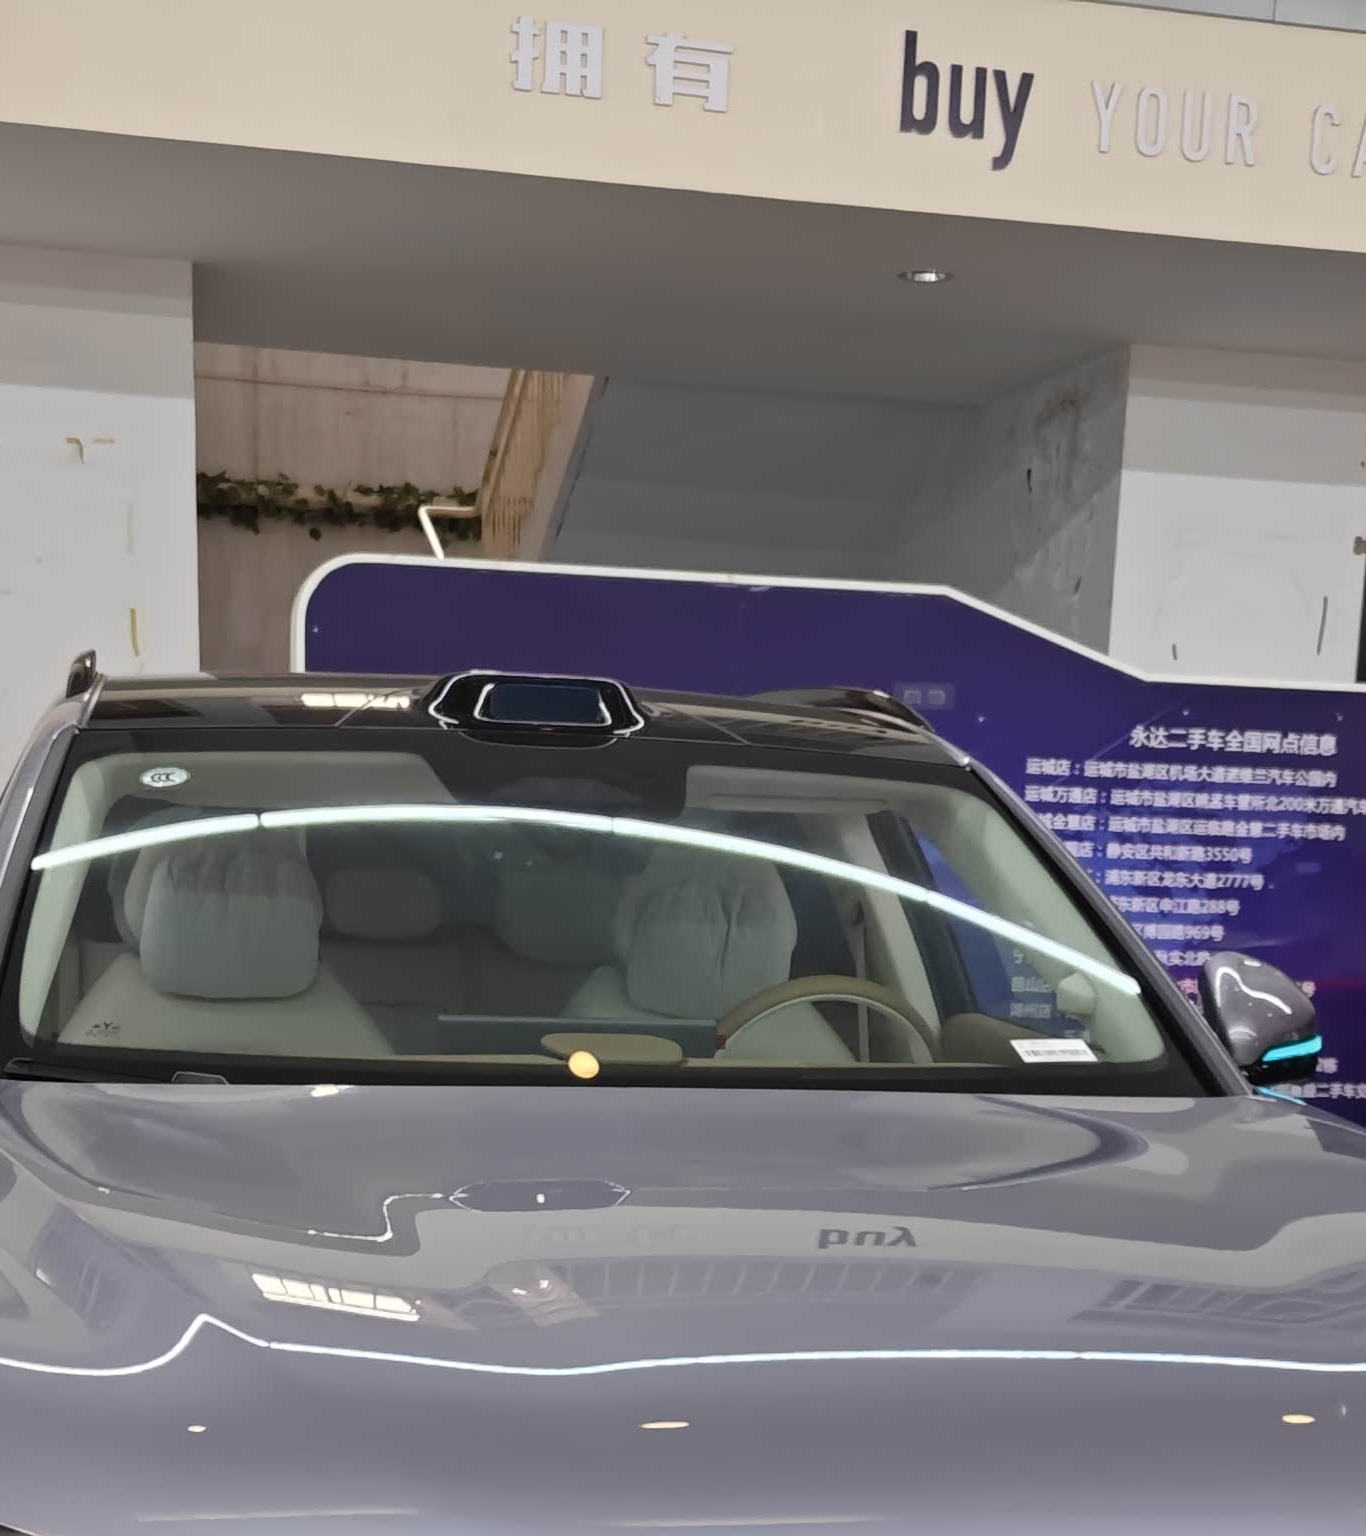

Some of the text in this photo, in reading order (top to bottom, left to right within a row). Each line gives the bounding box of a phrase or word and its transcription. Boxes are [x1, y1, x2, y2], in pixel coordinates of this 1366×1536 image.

[510, 16, 734, 113] 拥有
[899, 30, 1035, 171] buy
[1091, 79, 1258, 167] YOUR
[1129, 725, 1337, 755] 永达二手车全国网点信息
